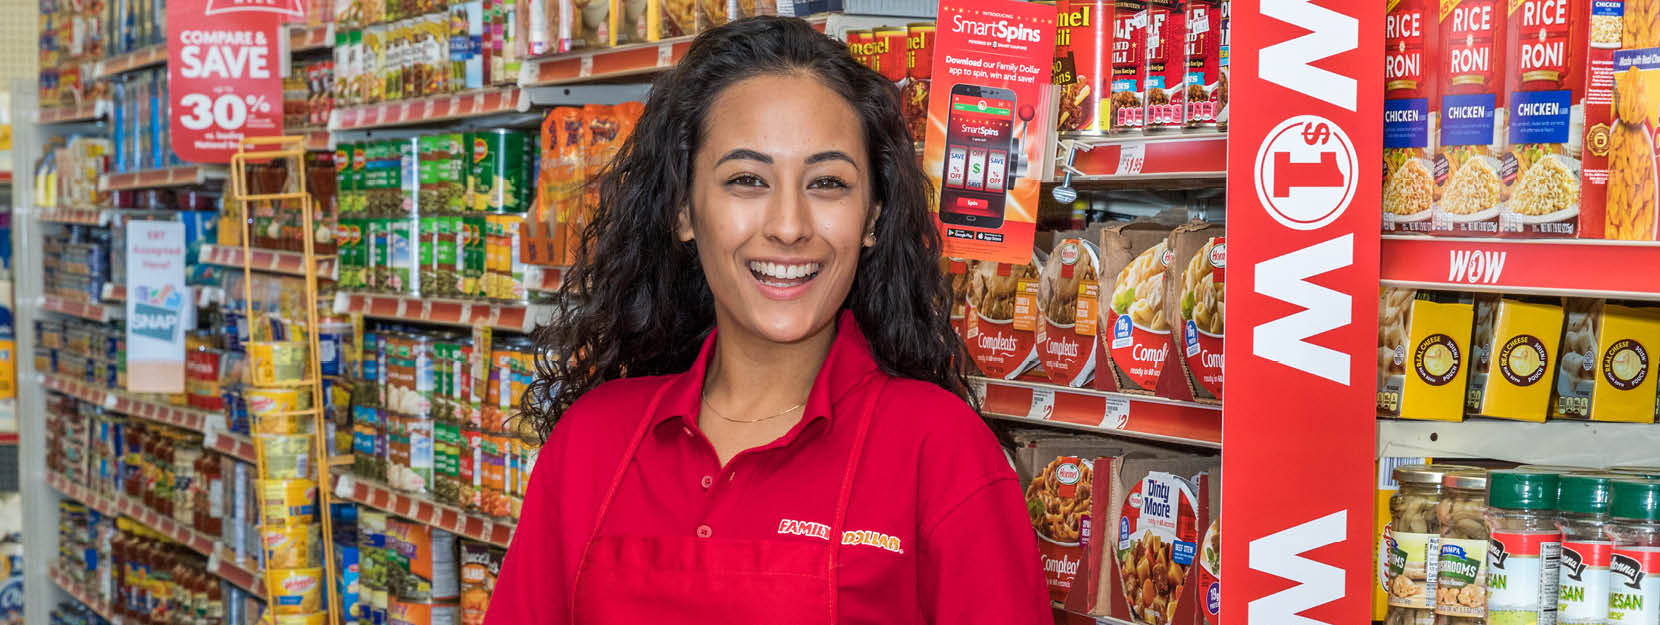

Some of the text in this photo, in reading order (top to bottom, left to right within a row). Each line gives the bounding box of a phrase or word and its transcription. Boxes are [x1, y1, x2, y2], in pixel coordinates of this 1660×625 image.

[1453, 5, 1491, 33] RICE
[1523, 0, 1567, 27] RICE
[952, 15, 1041, 43] SmartSpins
[1386, 12, 1421, 39] RICE
[181, 30, 267, 45] COMPARE &
[181, 45, 270, 79] SAVE
[945, 55, 982, 67] Download
[997, 61, 1018, 73] Family
[1019, 64, 1041, 75] Dollar
[1386, 52, 1420, 78] RONI
[1451, 46, 1489, 73] RONI
[1521, 41, 1564, 70] RONI
[949, 66, 963, 76] app
[964, 68, 972, 76] to
[973, 69, 989, 79] spin,
[1003, 73, 1016, 81] and
[1385, 109, 1419, 123] CHICKEN
[1448, 105, 1485, 119] CHICKEN
[1518, 102, 1560, 117] CHICKEN
[961, 124, 999, 137] SmartSpins
[951, 152, 965, 161] SAVE
[990, 157, 1004, 166] SAVE
[950, 172, 961, 180] OFF
[133, 311, 178, 329] SNAP
[977, 331, 1018, 355] Compleats
[1046, 335, 1079, 361] Compleats
[1506, 336, 1529, 350] CHEESE
[1130, 366, 1143, 377] ready
[1527, 367, 1544, 383] POUCH
[1148, 479, 1170, 503] Dinty
[1144, 497, 1171, 519] Moore
